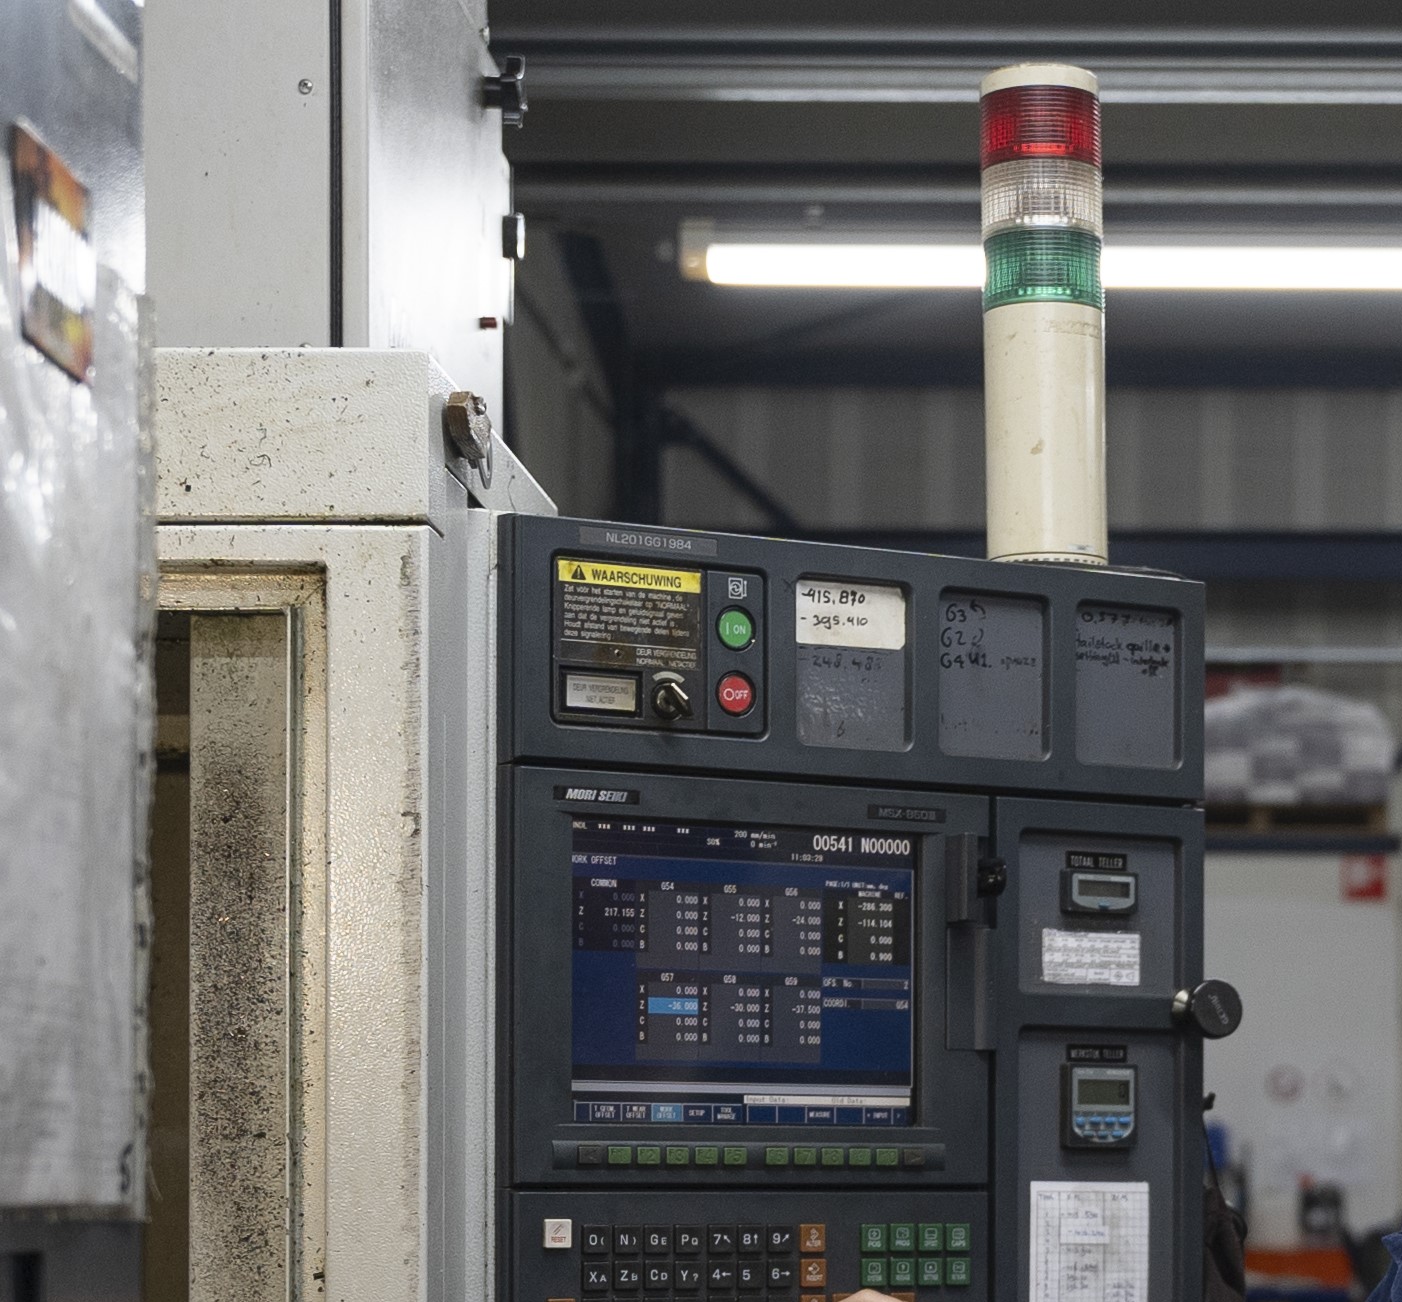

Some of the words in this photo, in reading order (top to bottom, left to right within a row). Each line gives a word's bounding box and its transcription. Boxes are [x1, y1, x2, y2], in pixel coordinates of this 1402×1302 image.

[606, 532, 692, 550] NL201GG1984
[592, 569, 682, 588] WAARSCHUWING
[565, 788, 597, 801] MORI
[598, 790, 629, 803] SEIKI
[861, 837, 911, 855] N00000
[590, 855, 617, 866] OFFSET
[590, 879, 618, 888] COMMON
[660, 882, 675, 891] G54
[723, 884, 737, 894] G55
[785, 888, 798, 897] G56
[676, 895, 699, 905] 0.000
[738, 898, 761, 908] 0.000
[800, 901, 821, 910] 0.000
[604, 907, 636, 918] 217.155
[676, 910, 699, 920] 0.000
[730, 913, 761, 923] -12.000
[792, 916, 821, 926] -24.000
[676, 926, 699, 936] 0.000
[738, 929, 761, 938] 0.000
[800, 931, 821, 941] 0.000
[676, 941, 699, 951] 0.000
[738, 944, 761, 954] 0.000
[800, 947, 821, 956] 0.000
[660, 973, 674, 982] G57
[723, 975, 737, 984] G58
[784, 977, 798, 986] G59
[676, 986, 698, 995] 0.000
[738, 988, 760, 997] 0.000
[799, 990, 821, 999] 0.000
[676, 1017, 698, 1026] 0.000
[738, 1019, 760, 1028] 0.000
[799, 1021, 821, 1030] 0.000
[676, 1033, 698, 1042] 0.000
[738, 1034, 760, 1043] 0.000
[799, 1036, 821, 1045] 0.000
[551, 1236, 567, 1244] RESET
[713, 1233, 721, 1245] 7
[743, 1233, 751, 1245] 8
[772, 1232, 781, 1244] 9
[712, 1269, 721, 1280] 4
[742, 1269, 750, 1281] 5
[771, 1268, 780, 1280] 6
